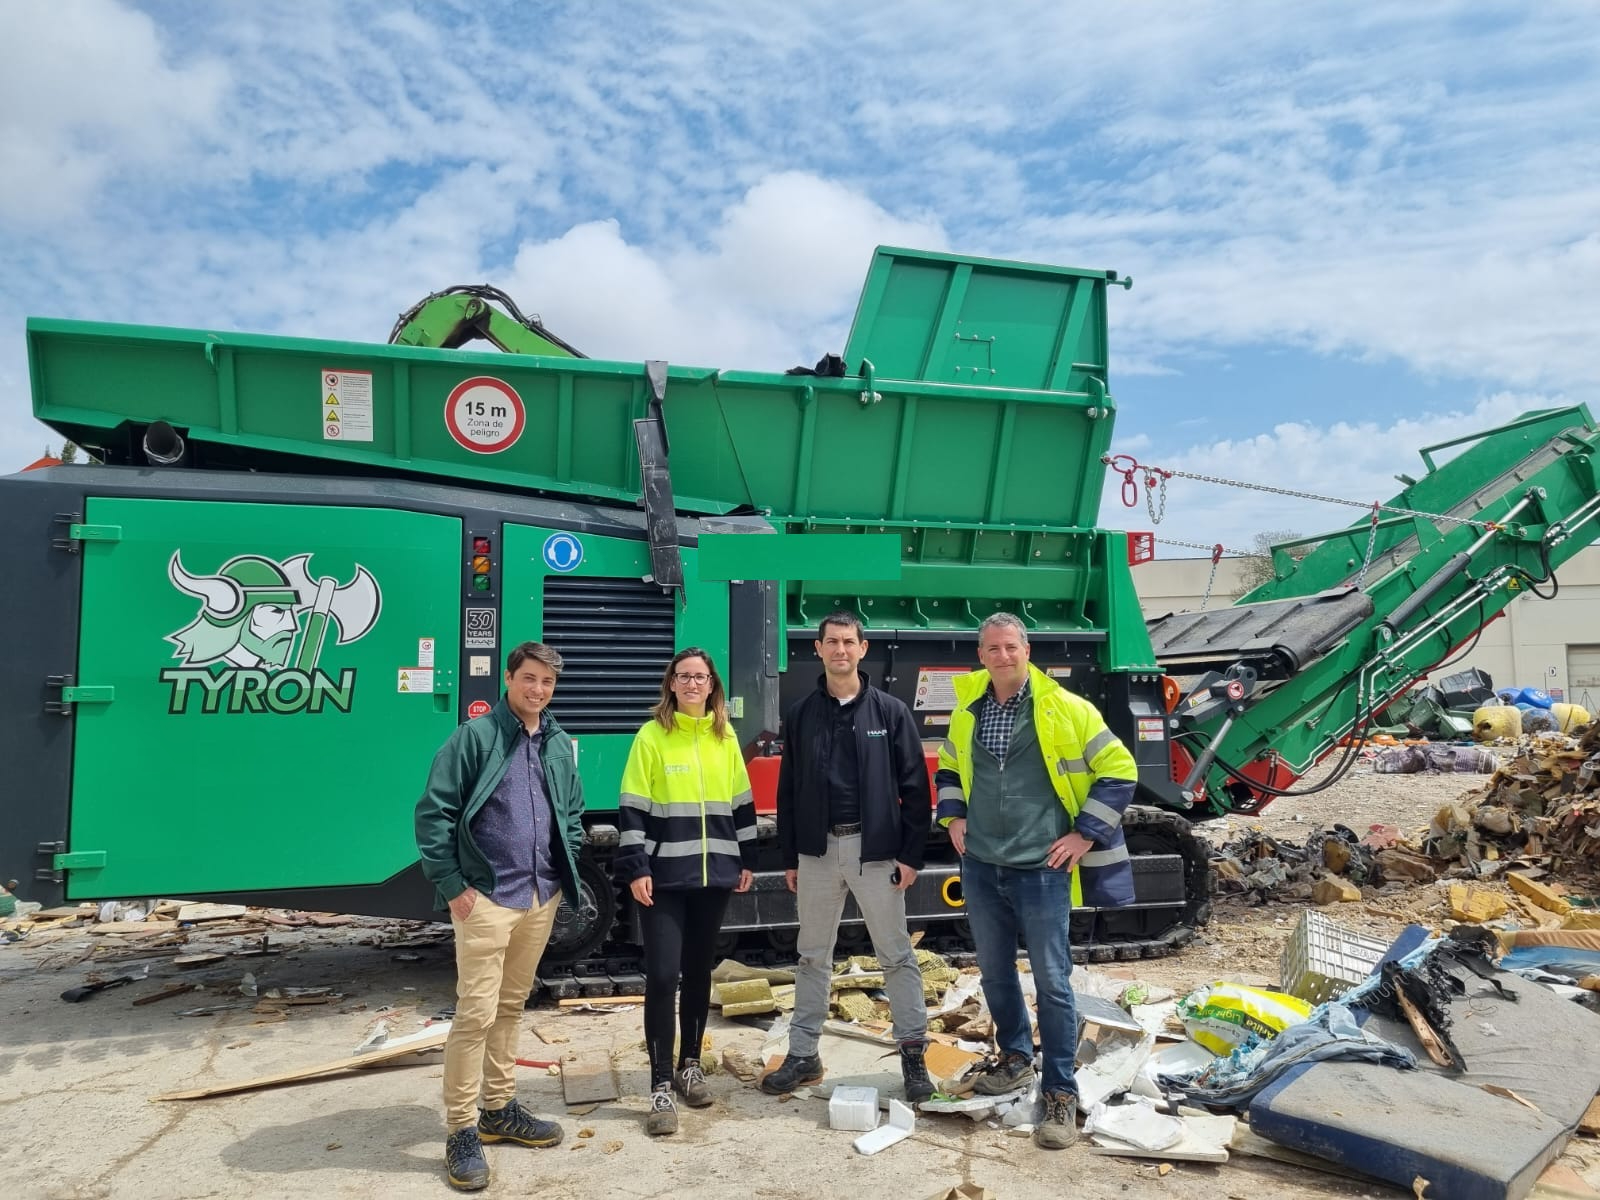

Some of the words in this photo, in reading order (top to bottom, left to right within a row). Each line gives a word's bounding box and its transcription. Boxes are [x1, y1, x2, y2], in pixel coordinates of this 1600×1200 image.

[465, 401, 485, 416] 15
[491, 406, 507, 418] m
[467, 418, 490, 427] Zona
[492, 420, 504, 428] de
[470, 428, 500, 437] peligro
[468, 610, 494, 630] 30
[159, 667, 357, 715] TYRON
[1216, 1009, 1241, 1022] Light
